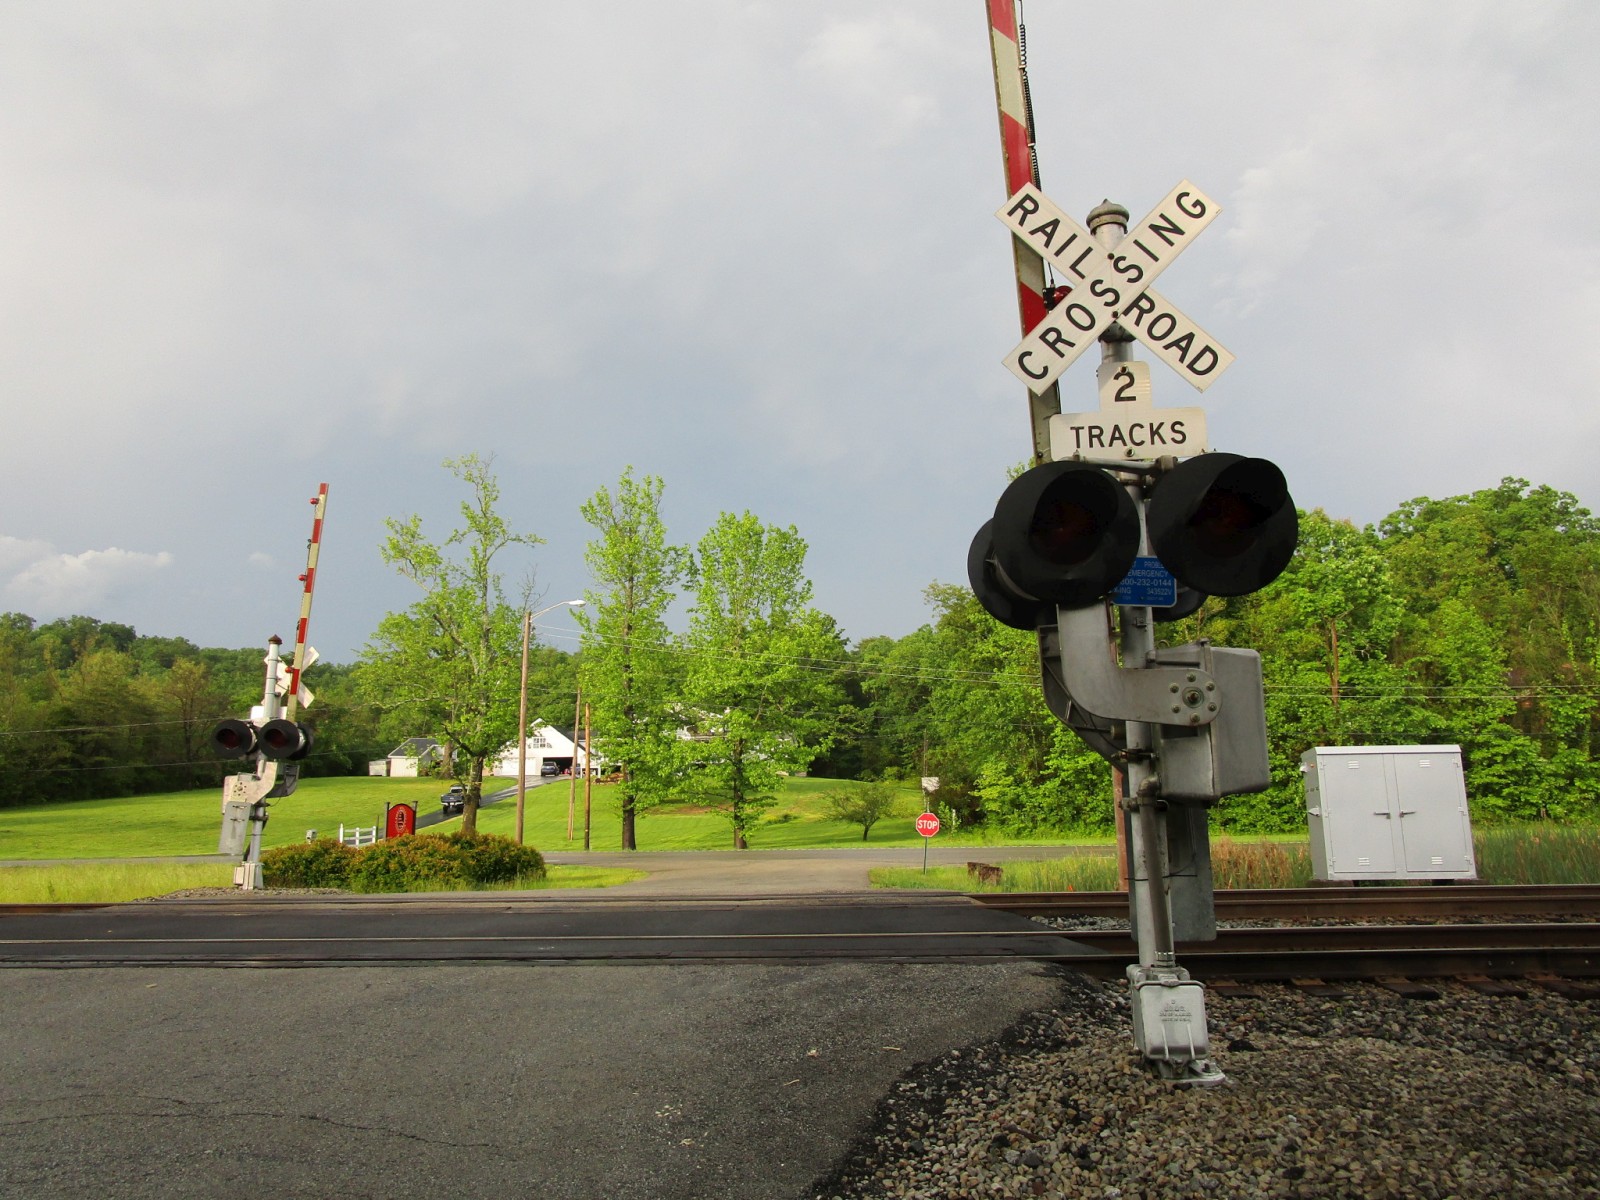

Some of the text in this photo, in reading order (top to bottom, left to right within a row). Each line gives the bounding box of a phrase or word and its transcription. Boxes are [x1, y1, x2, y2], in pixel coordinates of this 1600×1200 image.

[1007, 193, 1219, 376] RAIL ROAD
[1017, 191, 1207, 380] CROSSING
[1113, 371, 1137, 403] 2
[1070, 420, 1187, 449] TRACKS
[918, 820, 938, 830] STOP
